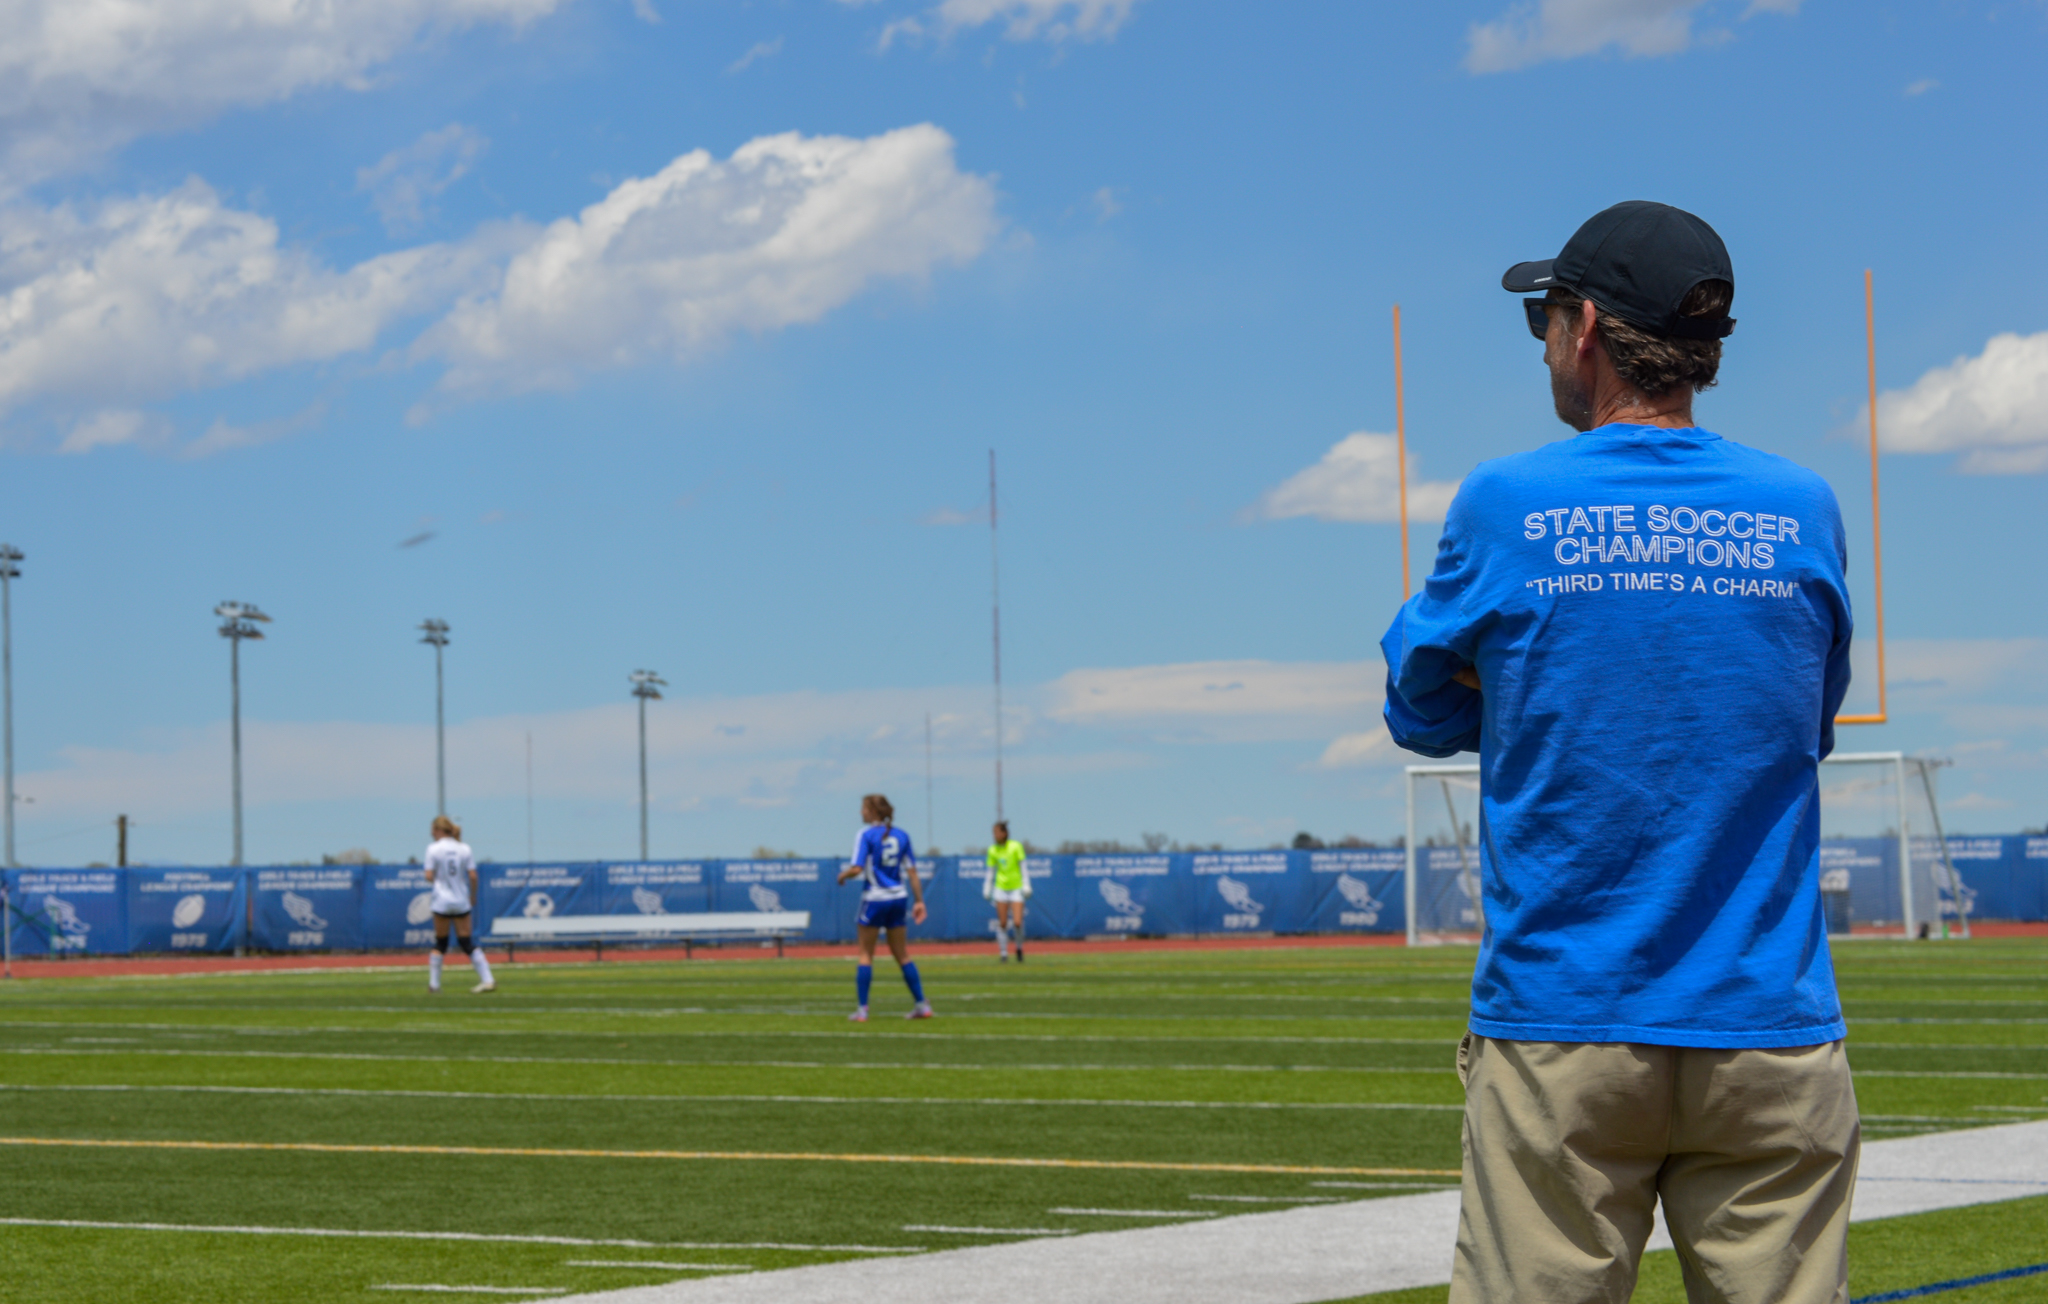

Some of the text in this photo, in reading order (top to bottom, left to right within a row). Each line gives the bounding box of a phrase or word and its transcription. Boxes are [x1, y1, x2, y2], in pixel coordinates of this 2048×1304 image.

[1524, 505, 1801, 545] STATE SOCCER
[1554, 535, 1775, 569] CHAMPIONS
[1610, 572, 1685, 591] TIME'S
[1691, 576, 1707, 593] A
[881, 836, 899, 867] 2
